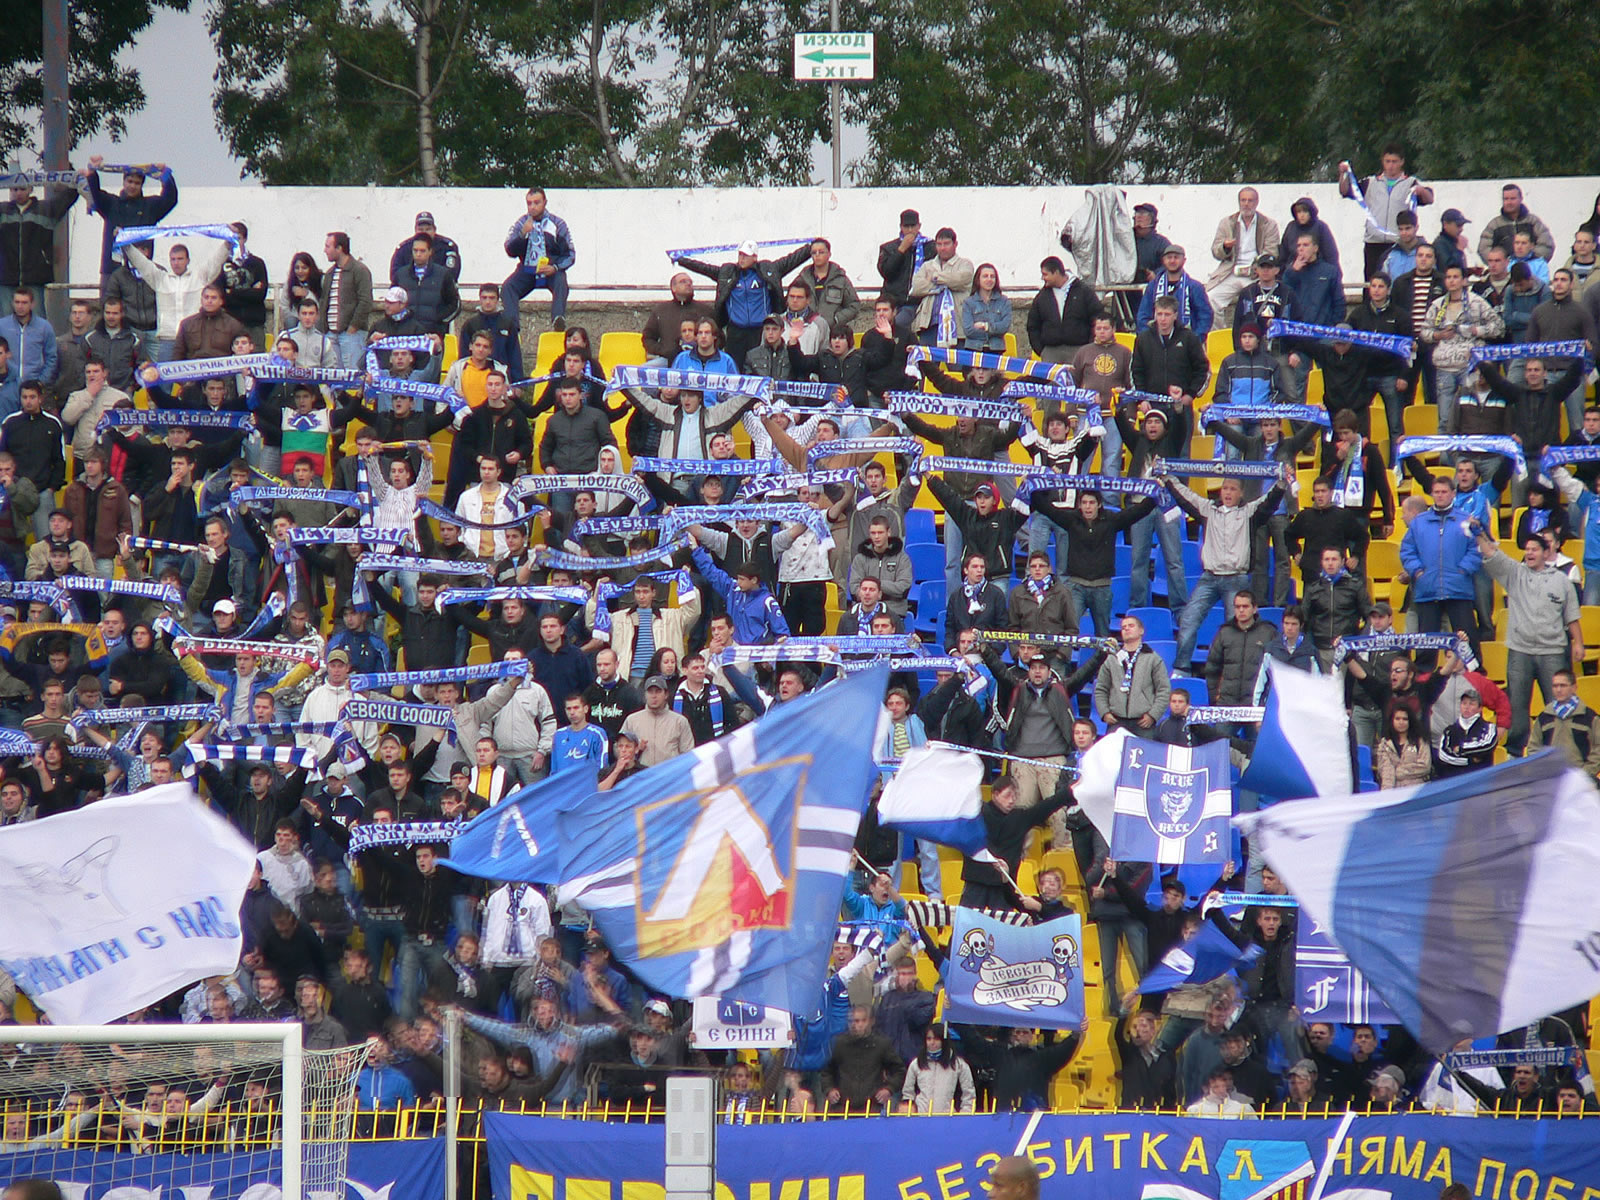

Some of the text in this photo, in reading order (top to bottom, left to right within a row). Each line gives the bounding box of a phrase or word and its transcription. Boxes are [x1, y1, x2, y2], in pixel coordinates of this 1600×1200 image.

[803, 35, 866, 48] ИЗХОД
[811, 66, 858, 78] EXIT
[200, 360, 224, 370] PARK
[400, 381, 445, 397] СОФИЯ
[119, 412, 177, 423] ЛЕВСКИ
[721, 462, 772, 474] SOFIA
[533, 476, 568, 489] BLUE
[578, 475, 647, 503] HOOLIGANS
[588, 518, 649, 532] LEVSKI
[983, 631, 1091, 644] ЛЕВСКИ 1914
[377, 669, 439, 683] ЛЕВСКИ
[445, 662, 500, 678] СОФИЯ
[164, 706, 198, 717] 1914
[400, 706, 451, 726] СОФИЯ
[725, 1027, 777, 1042] СИНЯ
[1026, 1132, 1210, 1181] БИТКА
[1328, 1135, 1453, 1188] НЯМА
